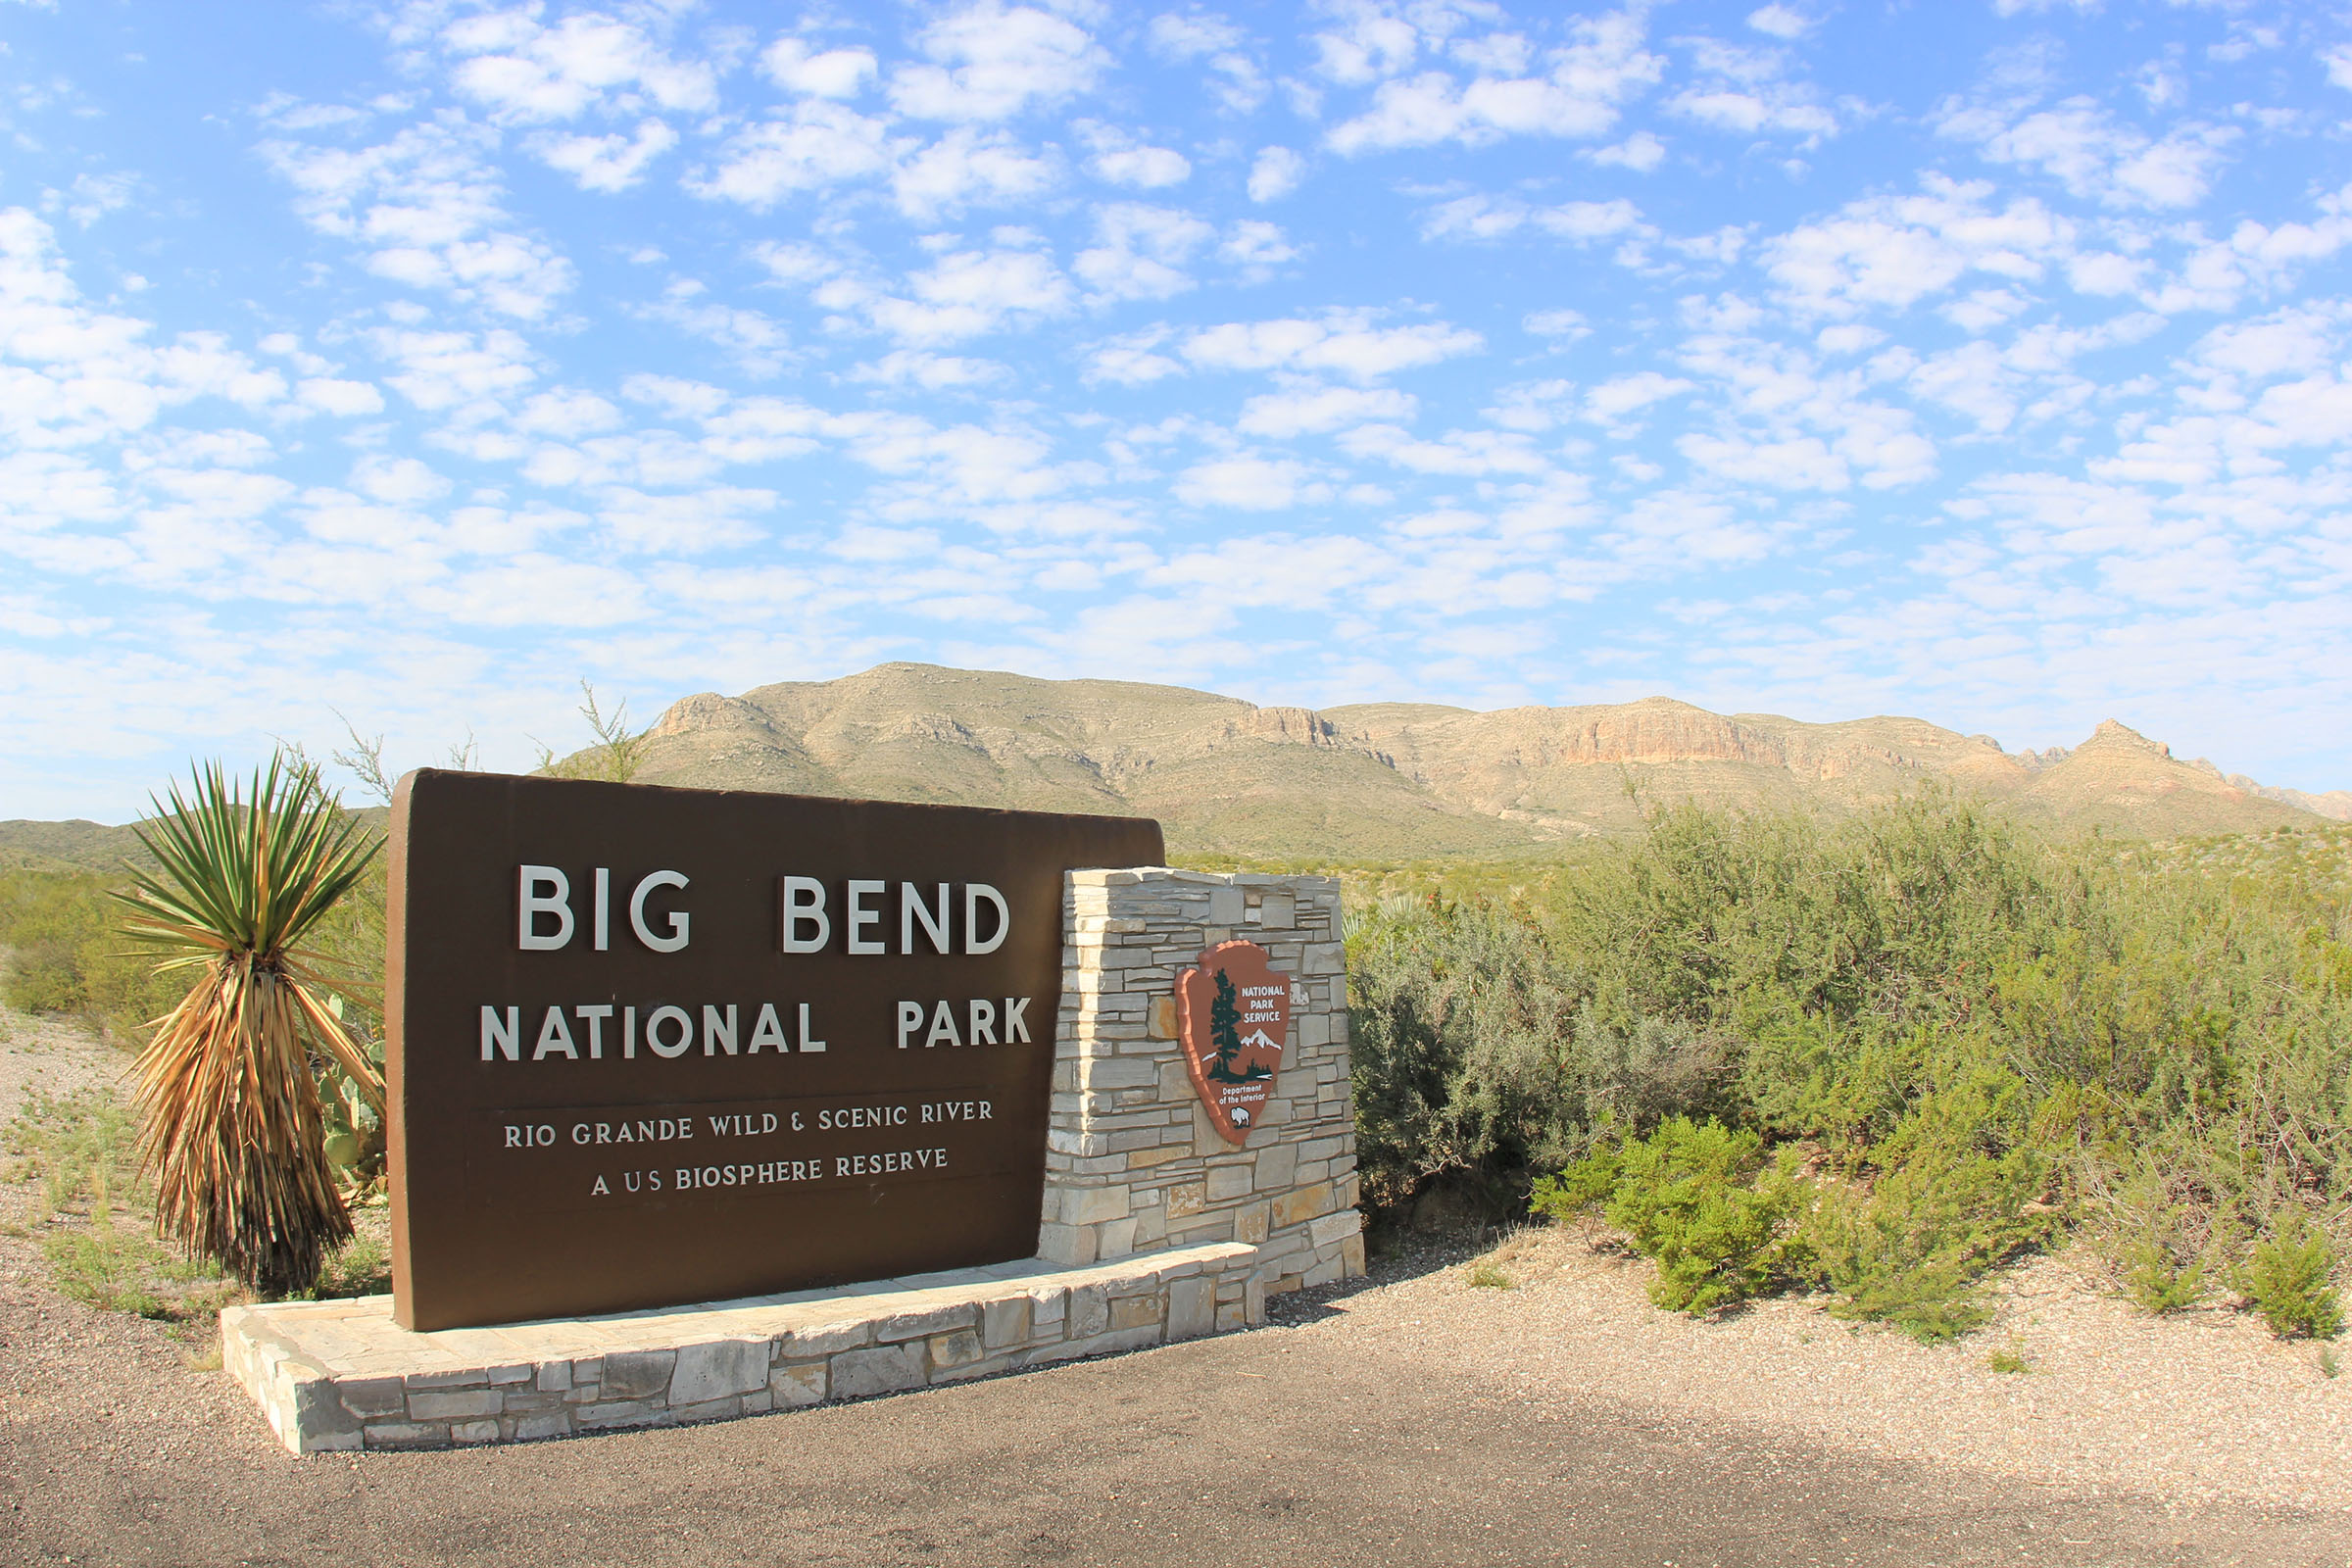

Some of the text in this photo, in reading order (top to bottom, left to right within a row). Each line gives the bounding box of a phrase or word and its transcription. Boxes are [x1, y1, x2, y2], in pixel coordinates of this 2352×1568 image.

[518, 864, 1009, 955] BIG BEND
[1242, 985, 1285, 998] NATIONAL
[1250, 999, 1274, 1010] PARK
[1244, 1011, 1280, 1023] SERVICE
[481, 997, 1032, 1061] NATIONAL PARK
[1222, 1084, 1262, 1096] Department
[1219, 1093, 1265, 1105] of the Interior
[504, 1101, 993, 1148] RIO GRANDE WILD & SCENIC RIVER
[591, 1175, 611, 1196] A
[675, 1159, 823, 1190] BIOSPHERE
[835, 1148, 948, 1177] RESERVE
